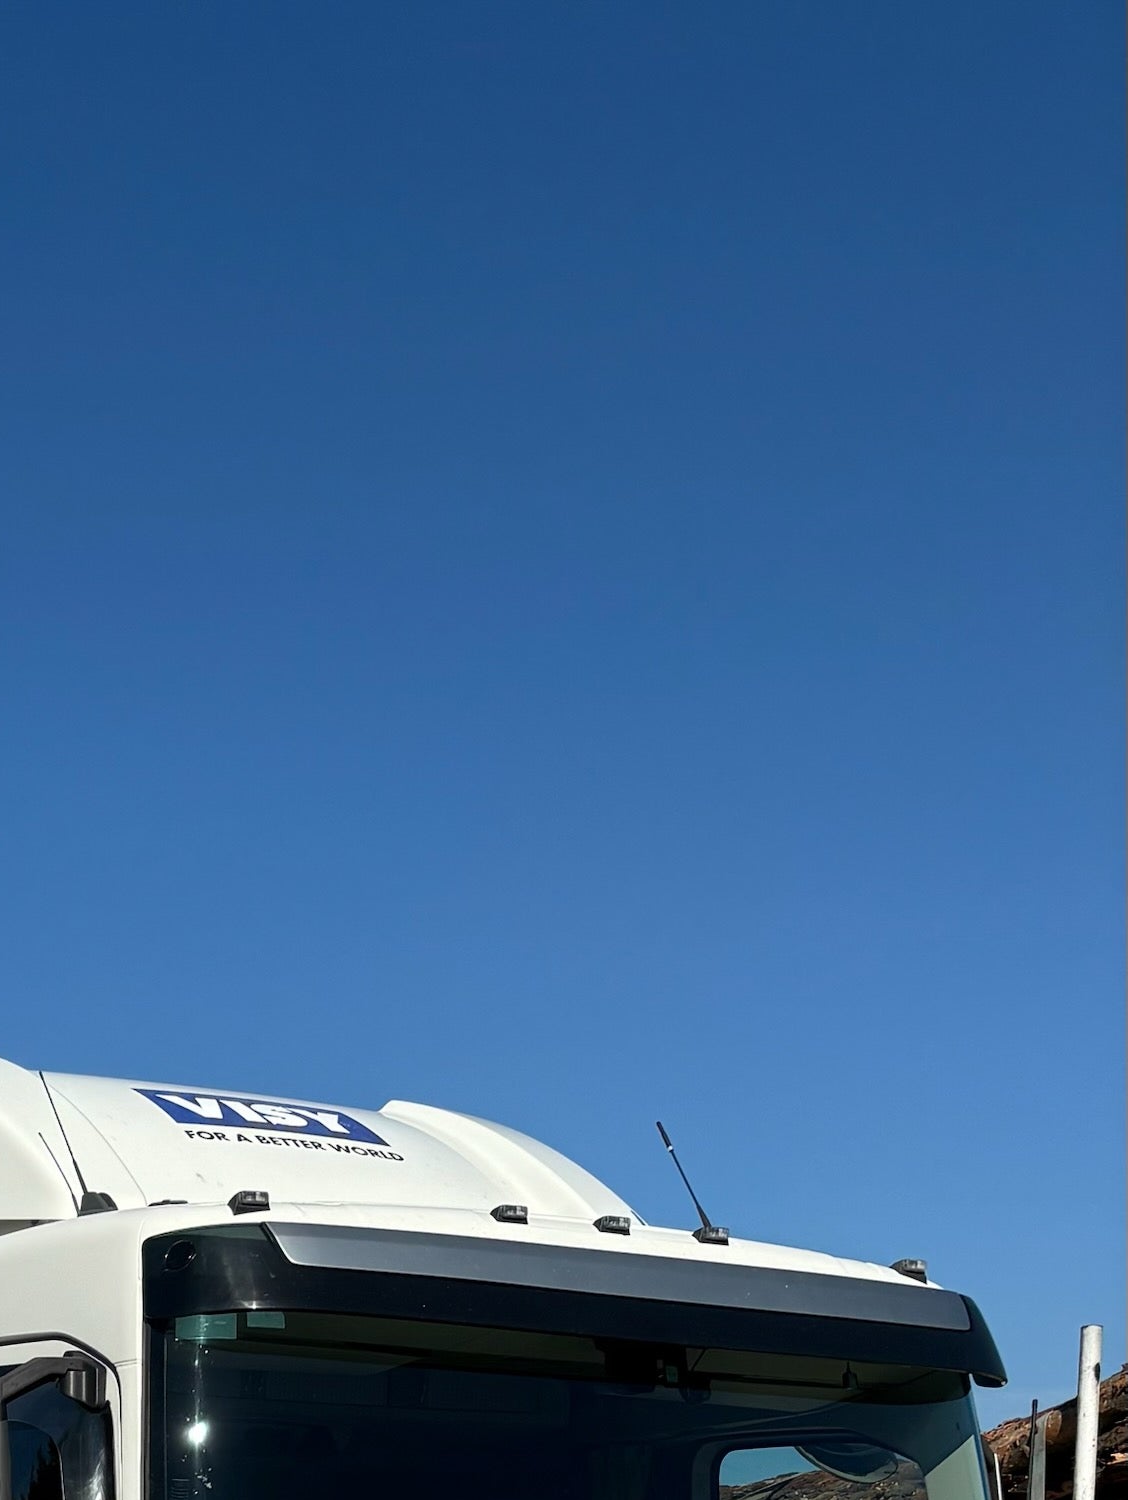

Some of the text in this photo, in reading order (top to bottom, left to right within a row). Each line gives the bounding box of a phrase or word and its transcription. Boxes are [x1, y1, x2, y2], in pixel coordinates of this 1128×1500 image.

[155, 1093, 351, 1135] VISY
[184, 1129, 405, 1162] FOR A BETTER WORLD
